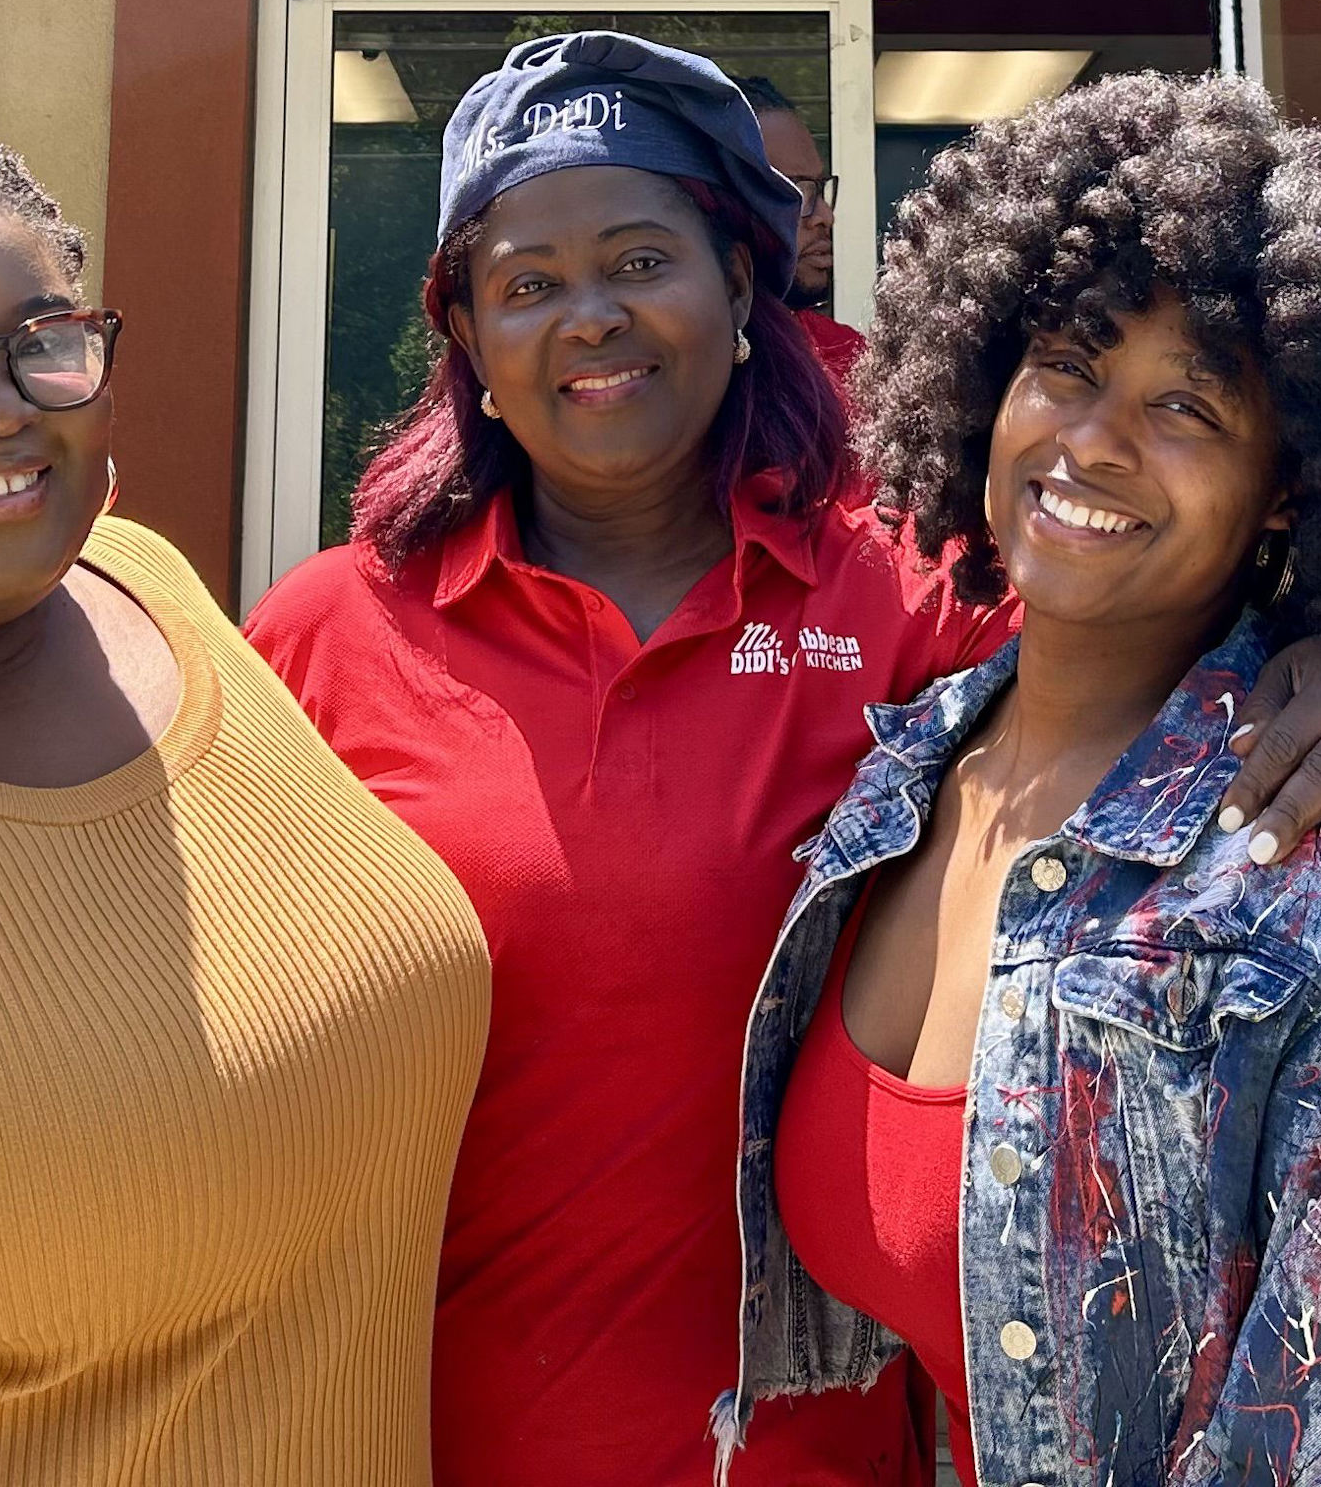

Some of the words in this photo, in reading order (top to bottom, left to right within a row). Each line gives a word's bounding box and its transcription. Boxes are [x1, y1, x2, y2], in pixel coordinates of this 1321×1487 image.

[458, 114, 505, 181] Ms.
[523, 91, 627, 141] DiDi
[730, 649, 789, 676] DIDI's
[797, 625, 861, 655] ibbean
[733, 621, 783, 651] Ms.
[805, 651, 863, 672] KITCHEN
